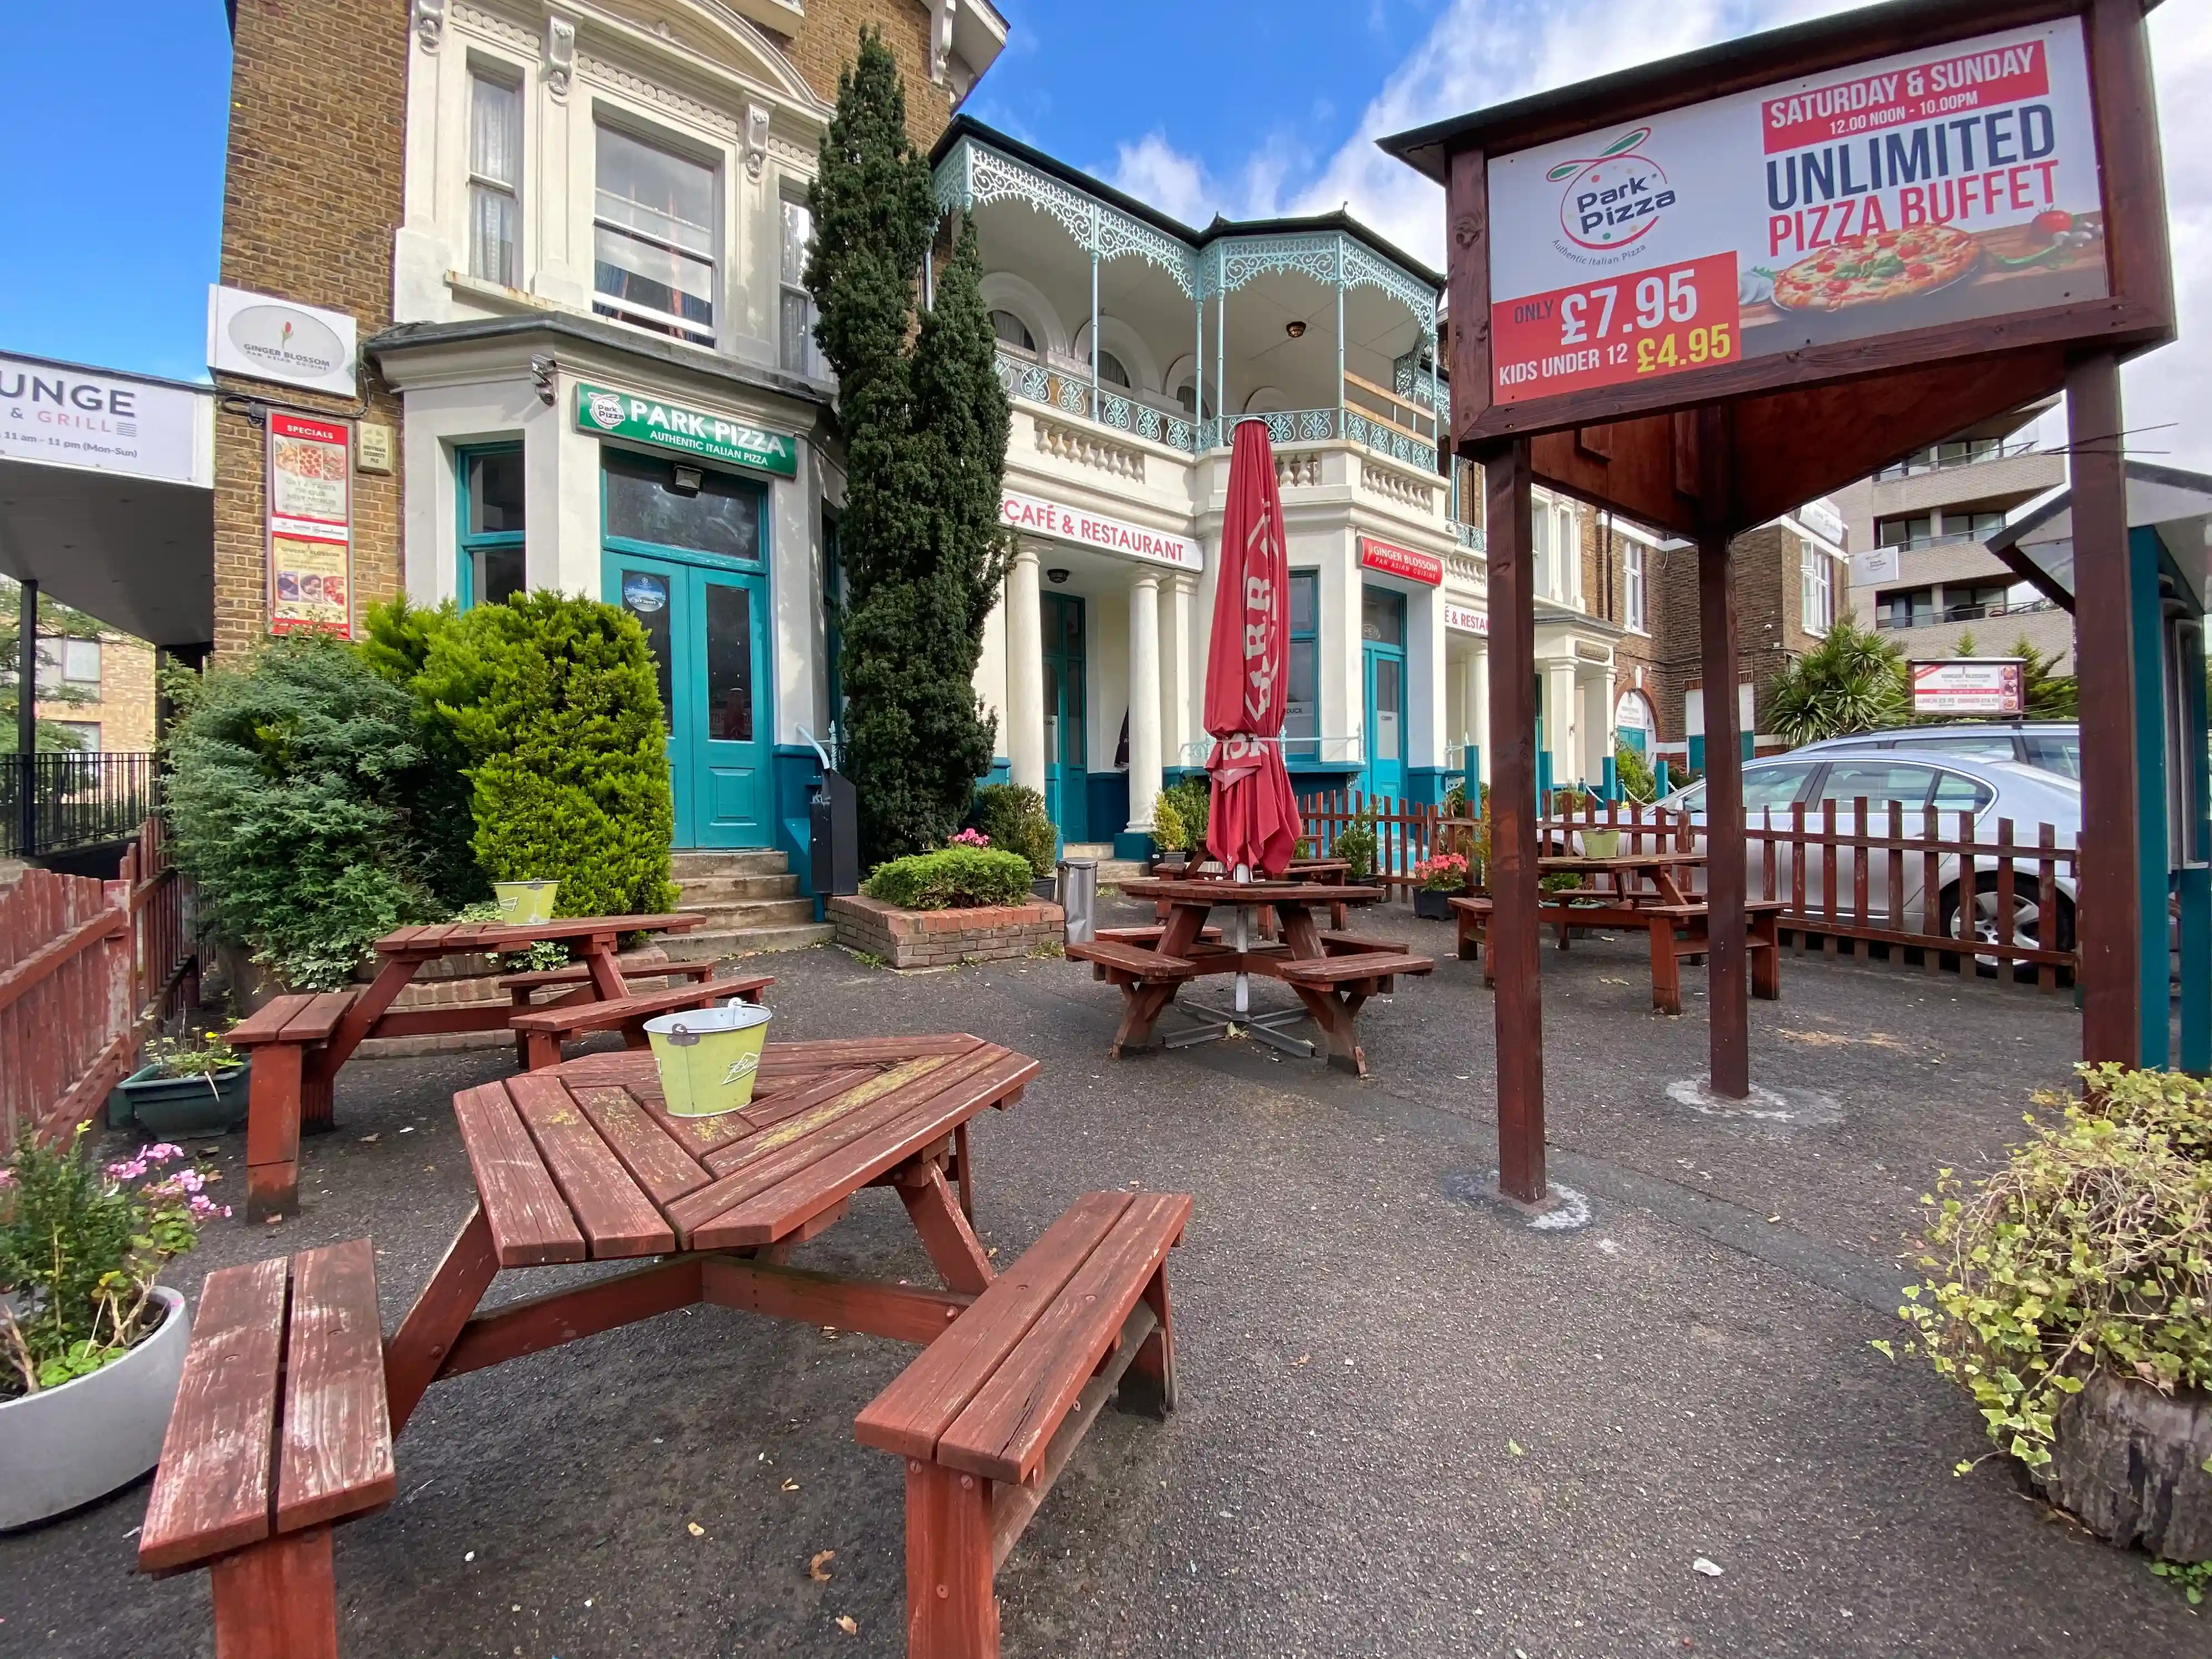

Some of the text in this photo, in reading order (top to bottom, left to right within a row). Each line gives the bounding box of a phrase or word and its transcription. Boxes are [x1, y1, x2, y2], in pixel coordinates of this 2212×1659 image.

[1770, 44, 2034, 129] SATURDAY & SUNDAY
[1829, 114, 1866, 136] 12.00
[1869, 105, 1905, 127] NOON
[1919, 91, 1978, 116] 10.00PM
[1767, 103, 2055, 211] UNLIMITED
[1576, 176, 1648, 214] Park
[1580, 189, 1676, 234] Pizza
[1769, 159, 2059, 257] PIZZA BUFFET
[1552, 239, 1646, 265] Authentic Italian Pizza
[1513, 268, 1697, 346] ONLY £7.95
[244, 344, 330, 367] GINGER BLOSSOM
[1499, 323, 1731, 386] KIDS UNDER 12 £4.95
[11, 408, 111, 432] & GRILL
[598, 404, 617, 412] Park
[599, 410, 625, 419] Pizza
[287, 424, 333, 439] SPECIALS
[630, 399, 786, 458] PARK PIZZA
[48, 438, 60, 446] 11
[63, 440, 81, 449] pm
[83, 443, 137, 458] (Mon-Sun)
[650, 430, 768, 466] AUTHENTIC ITALIAN PIZZA
[1004, 500, 1183, 562] CAFÉ & RESTAURANT
[1373, 546, 1438, 573] GINGER BLOSSOM
[1375, 557, 1436, 579] PAN ASIAN CUISINE
[1452, 611, 1458, 624] &
